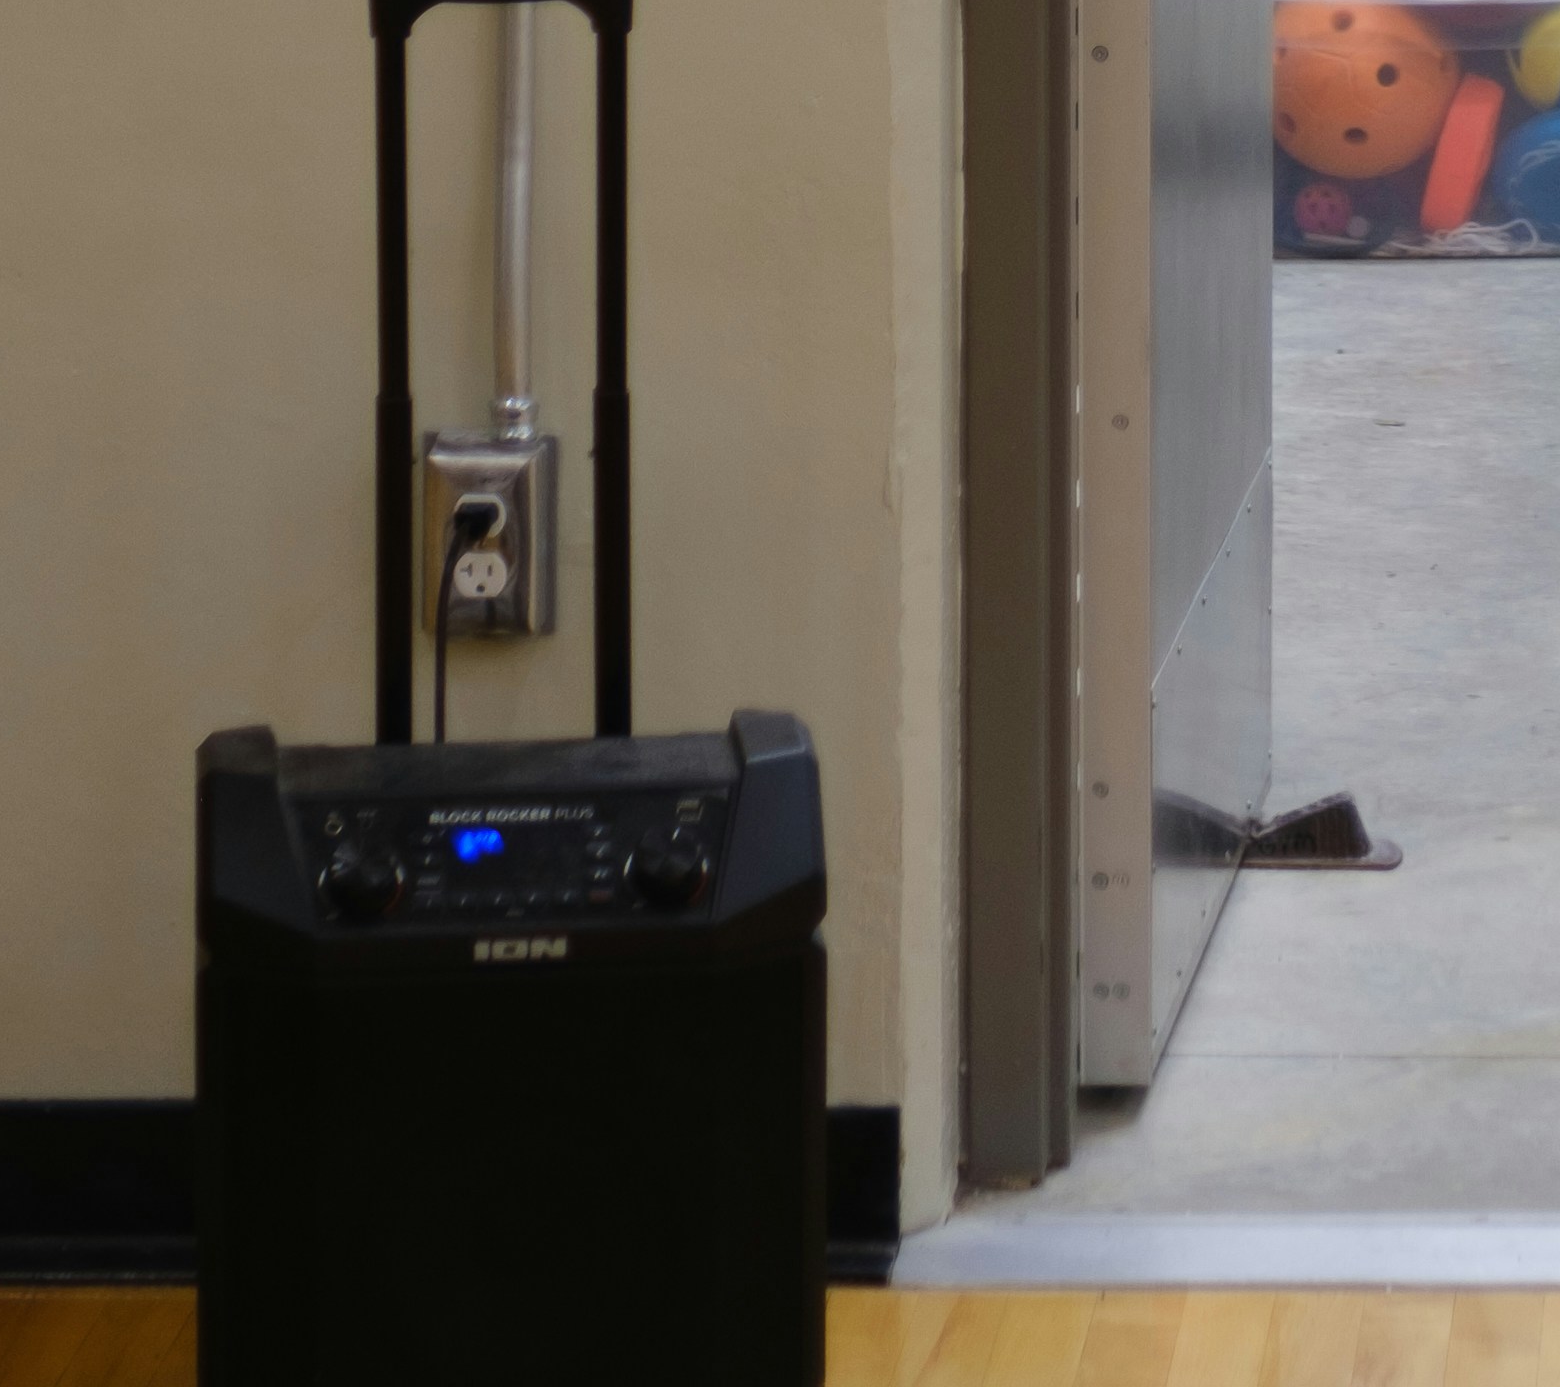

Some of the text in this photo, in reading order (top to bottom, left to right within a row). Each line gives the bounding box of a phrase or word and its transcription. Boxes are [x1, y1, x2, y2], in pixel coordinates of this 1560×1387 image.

[429, 810, 482, 824] BLOCK
[486, 809, 552, 822] ROCKER
[474, 937, 567, 961] ION
